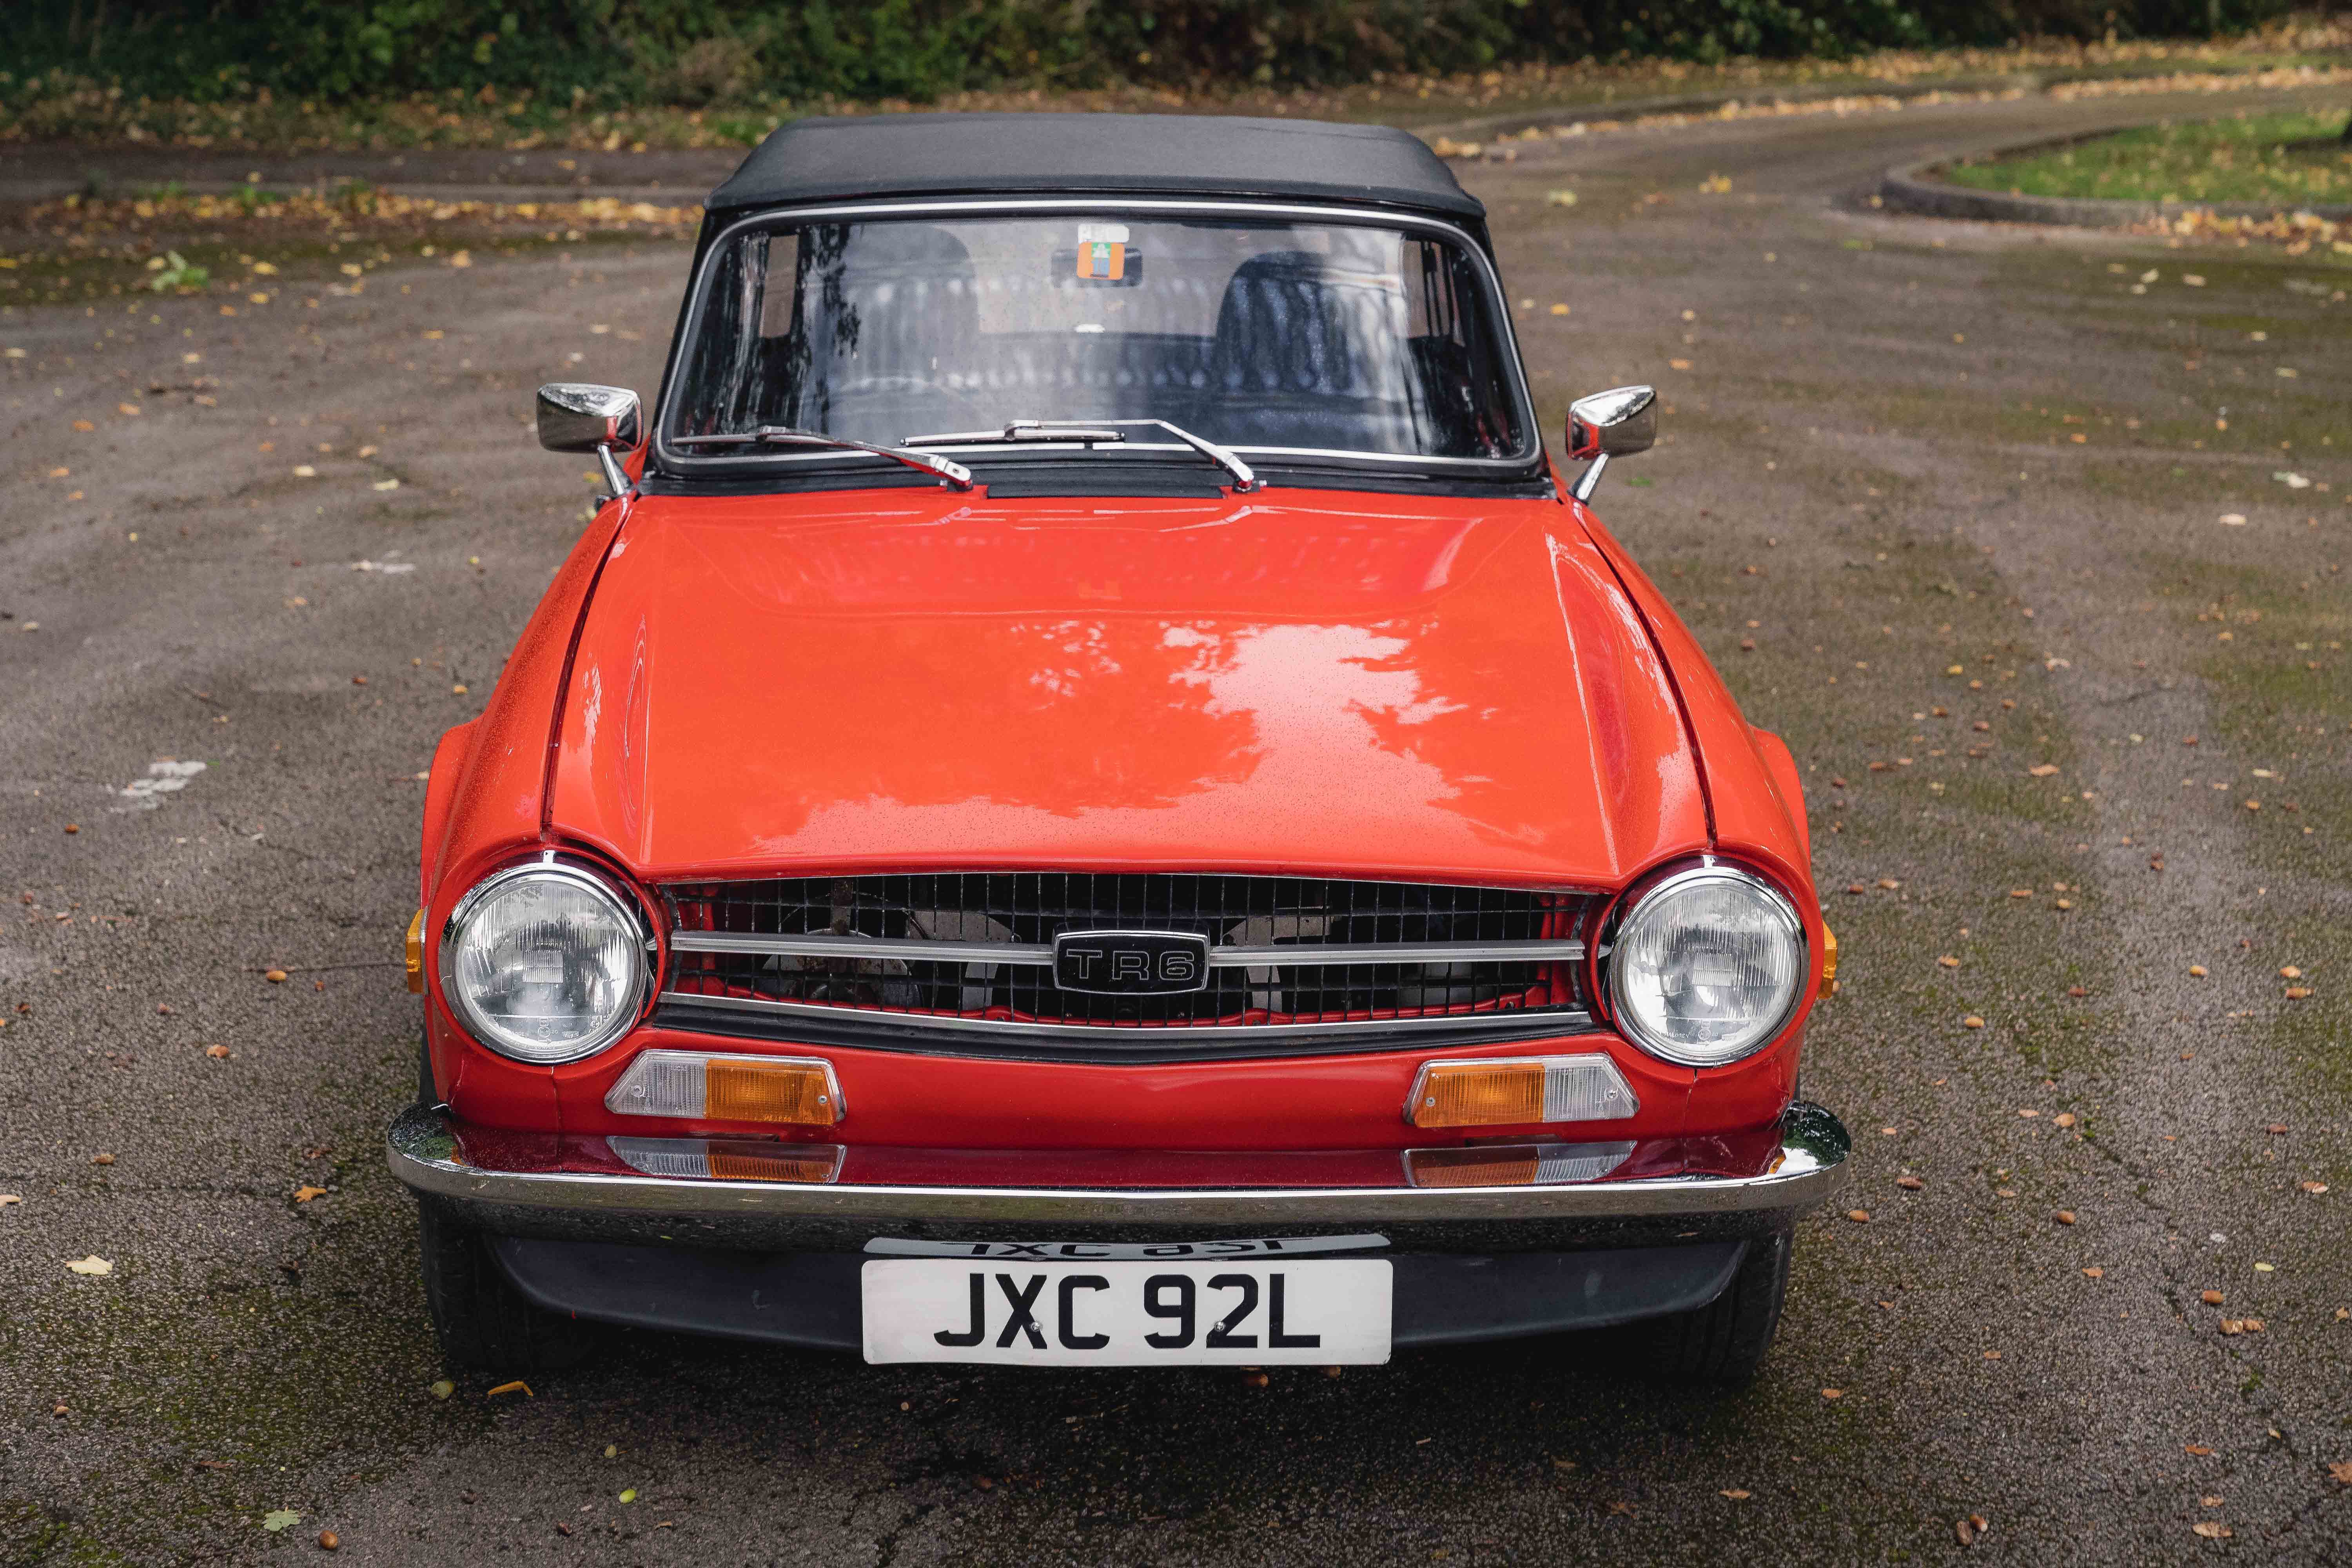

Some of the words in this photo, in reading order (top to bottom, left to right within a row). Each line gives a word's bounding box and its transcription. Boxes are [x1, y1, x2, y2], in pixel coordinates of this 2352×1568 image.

[1066, 949, 1194, 980] TR6
[934, 1273, 1110, 1350] JXC
[1144, 1273, 1321, 1349] 92L
